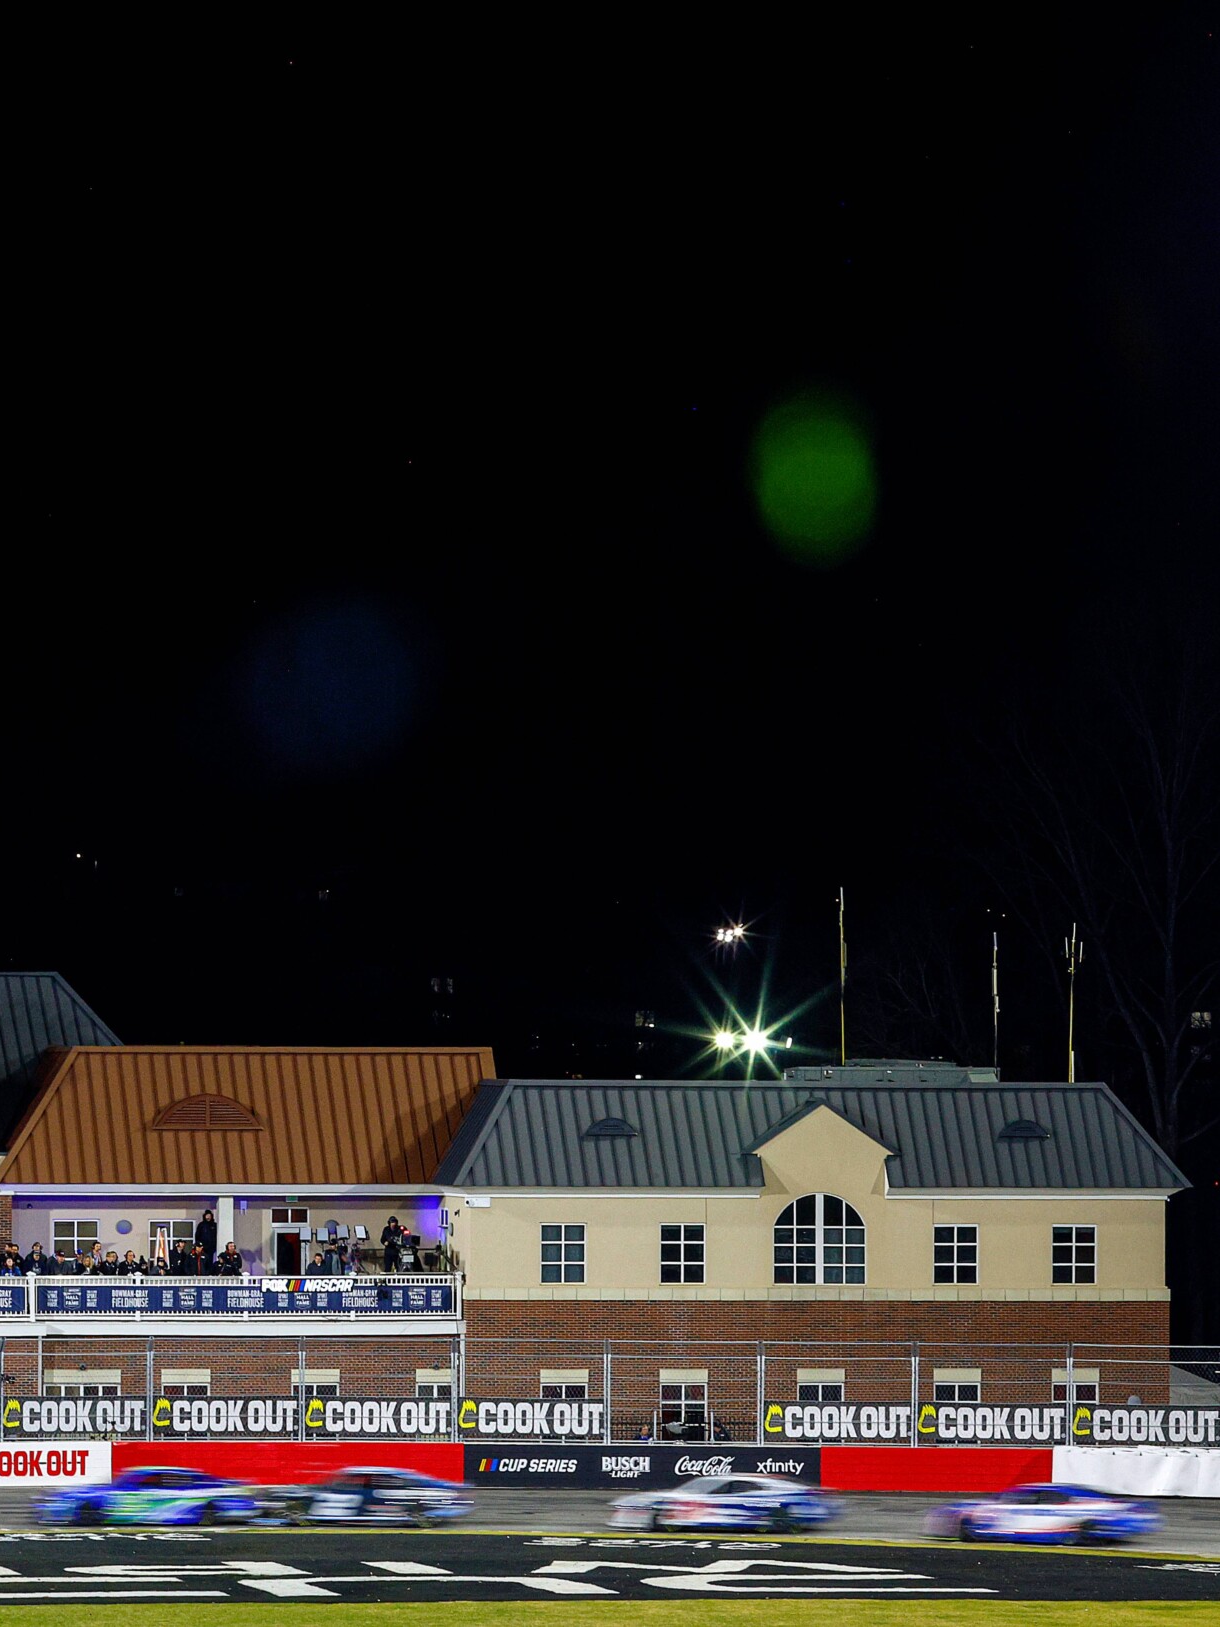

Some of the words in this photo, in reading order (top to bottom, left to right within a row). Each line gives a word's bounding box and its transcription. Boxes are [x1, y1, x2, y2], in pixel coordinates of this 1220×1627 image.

[112, 1290, 148, 1298] BOWMAN-GRAY
[262, 1279, 289, 1292] FOX
[304, 1279, 354, 1292] NASCAR
[112, 1298, 148, 1308] FIELDHOUSE
[227, 1298, 264, 1308] FIELDHOUSE
[342, 1297, 378, 1307] FIELDHOUSE
[22, 1400, 94, 1433] COOK
[96, 1400, 145, 1432] OUT
[172, 1400, 246, 1433] COOK
[247, 1400, 296, 1432] OUT
[325, 1401, 397, 1433] COOK
[400, 1401, 451, 1434] OUT
[478, 1402, 551, 1435] COOK
[553, 1403, 604, 1436] OUT
[784, 1405, 857, 1438] COOK
[860, 1406, 910, 1439] OUT
[937, 1407, 1010, 1440] COOK
[1013, 1408, 1066, 1441] OUT
[1092, 1409, 1166, 1442] COOK
[1168, 1410, 1219, 1443] OUT
[46, 1450, 89, 1476] OUT
[498, 1458, 528, 1472] CUP
[528, 1458, 578, 1473] SERIES
[601, 1456, 651, 1472] BUSCH
[756, 1458, 805, 1475] xfinity
